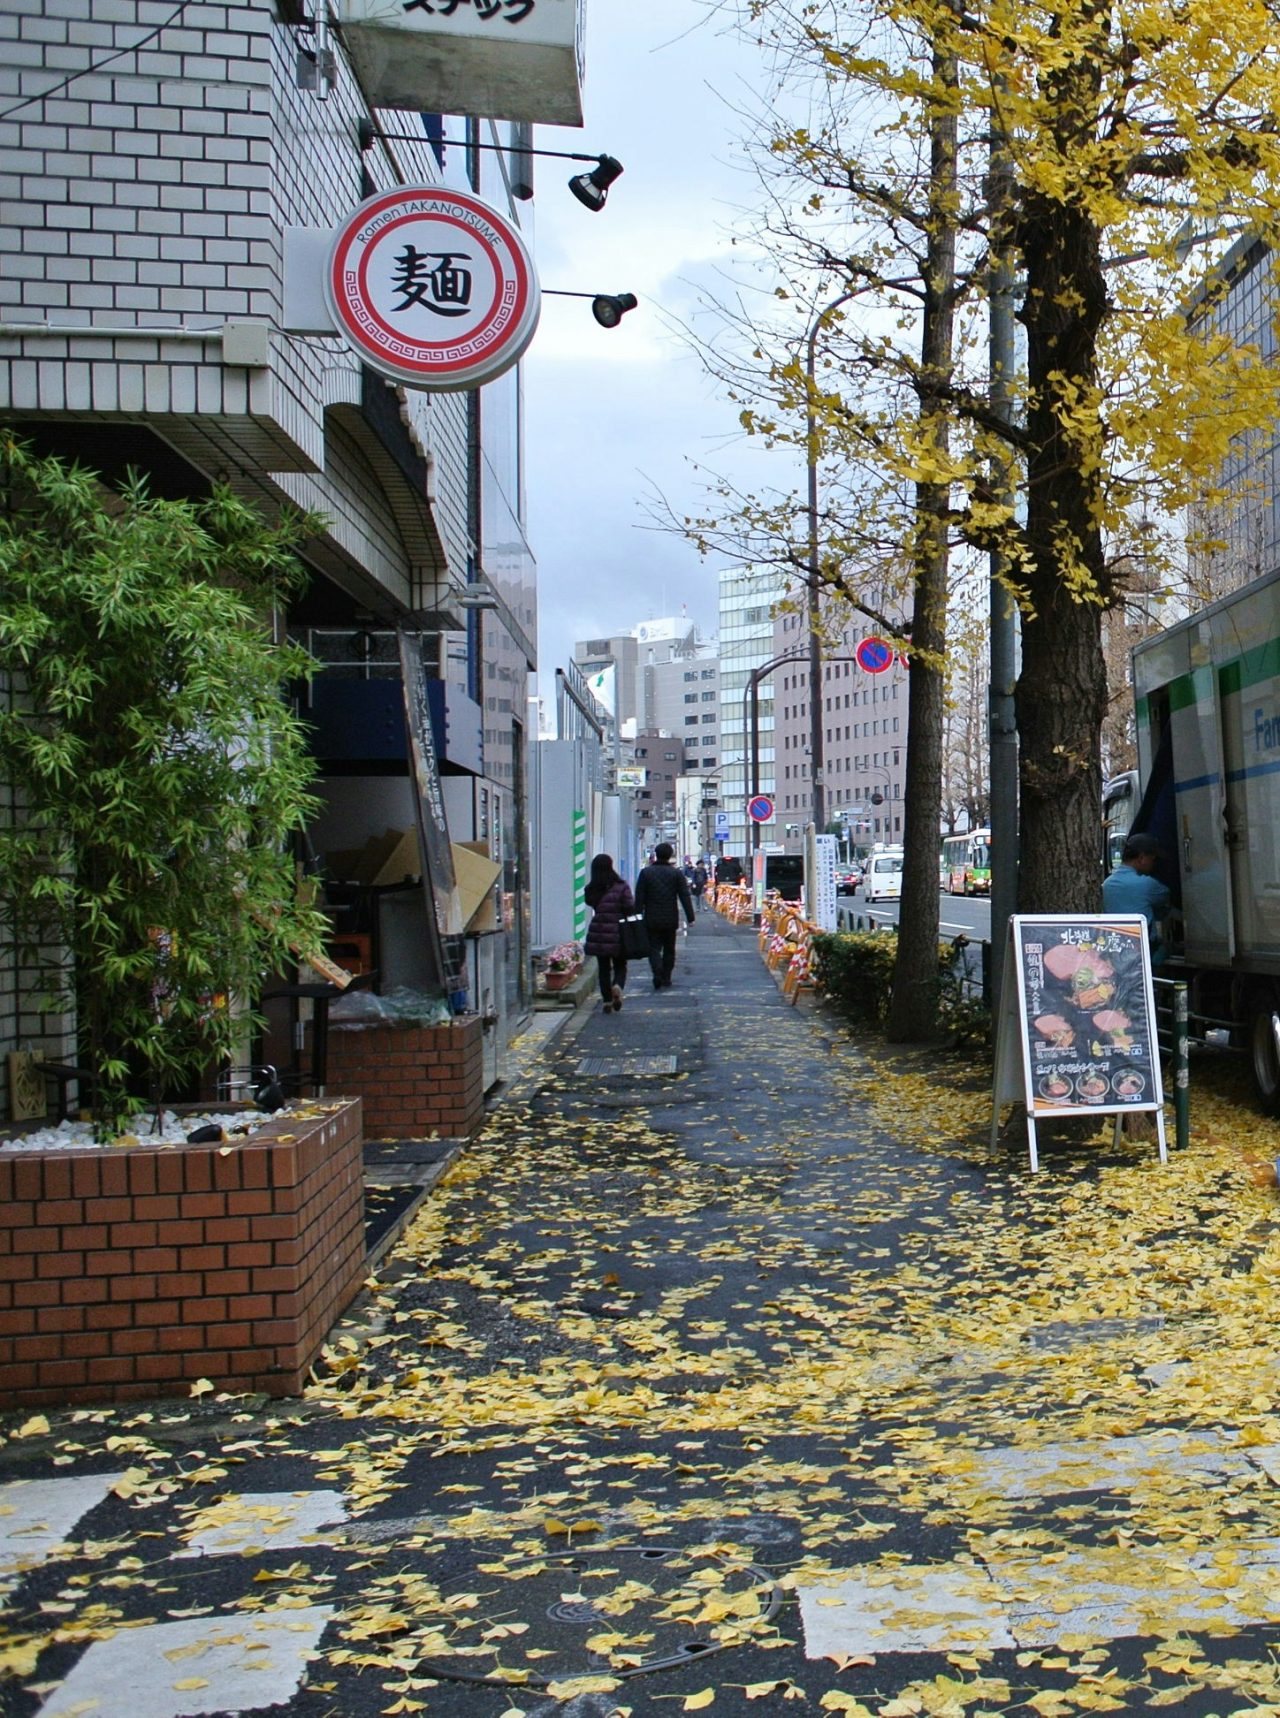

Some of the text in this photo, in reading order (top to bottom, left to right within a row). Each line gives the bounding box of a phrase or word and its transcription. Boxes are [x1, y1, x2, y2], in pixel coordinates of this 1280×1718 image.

[356, 200, 502, 247] Ramen TAKANOTSUME
[390, 244, 473, 318] 麺
[718, 814, 727, 825] P
